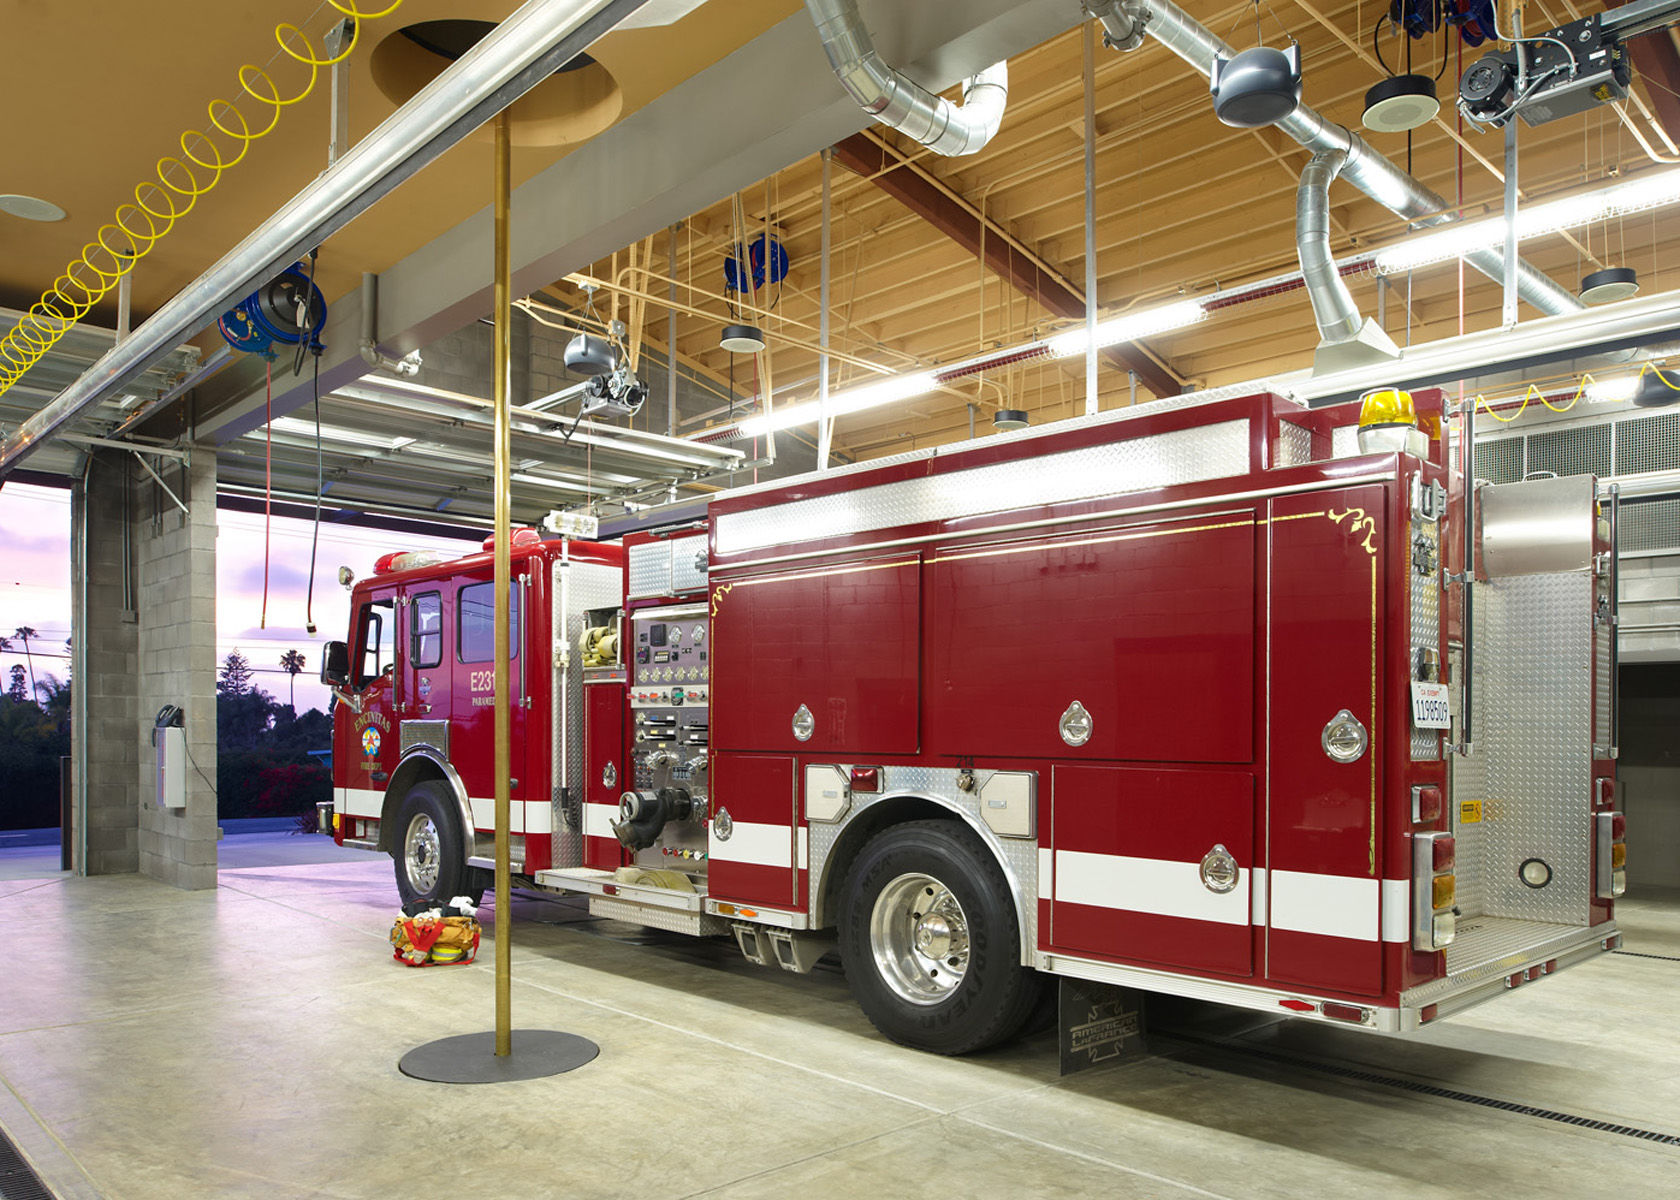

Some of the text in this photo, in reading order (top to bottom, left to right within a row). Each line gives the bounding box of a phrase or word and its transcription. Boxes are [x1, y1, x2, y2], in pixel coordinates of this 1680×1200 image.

[470, 671, 496, 692] E231
[354, 711, 391, 733] ENCINITAS
[1416, 699, 1448, 722] 1198509
[921, 891, 987, 1029] GOODYEAR
[1071, 1015, 1138, 1039] AMERICAN
